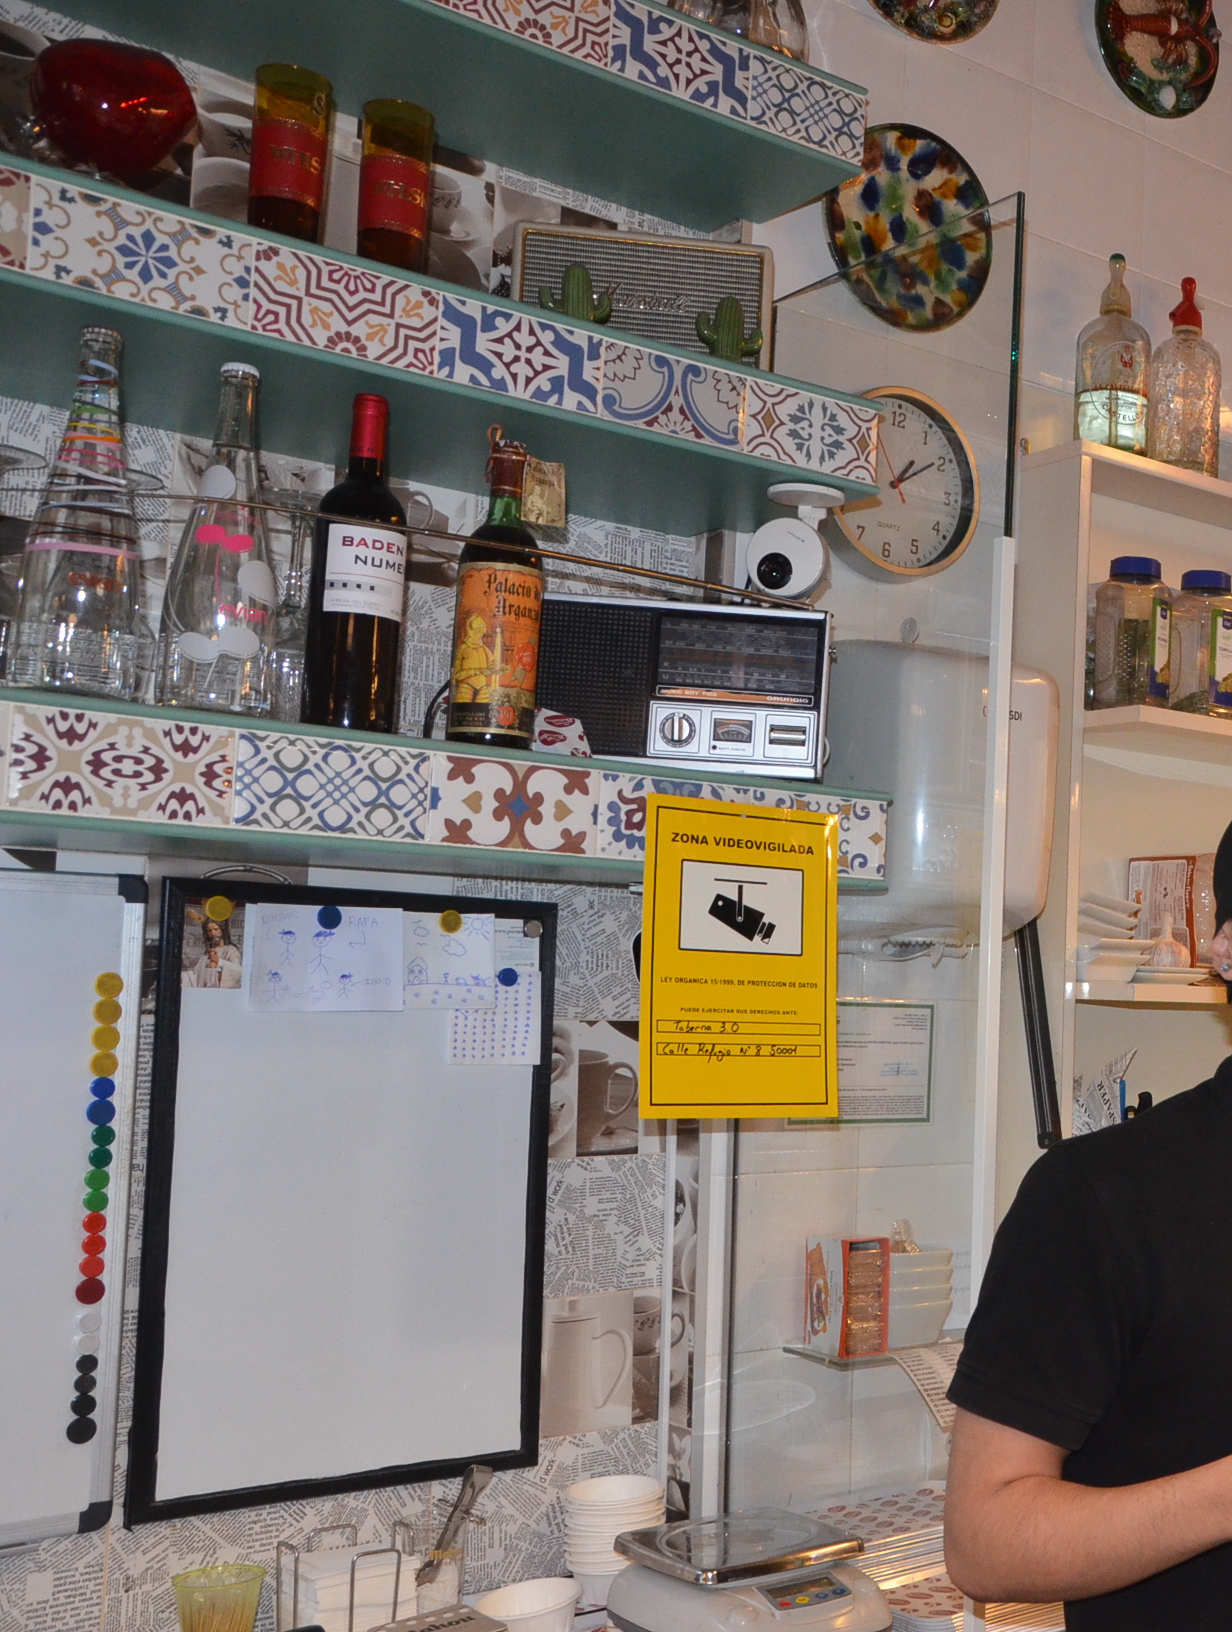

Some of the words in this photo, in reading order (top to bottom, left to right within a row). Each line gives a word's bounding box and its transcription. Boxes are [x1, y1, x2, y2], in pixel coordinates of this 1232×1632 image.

[891, 411, 906, 429] 12
[937, 456, 946, 472] 2
[944, 491, 952, 506] 3
[856, 525, 865, 541] 7
[877, 521, 900, 532] QUARTZ
[931, 521, 940, 535] 4
[342, 536, 404, 557] BADEN
[882, 542, 891, 558] 6
[910, 539, 919, 554] 5
[354, 554, 403, 574] NUME
[69, 571, 122, 593] evian
[484, 573, 532, 596] Palacio
[219, 602, 268, 624] evian
[671, 832, 709, 846] ZONA
[713, 836, 814, 855] VIDEOVIGILADA
[349, 916, 379, 927] RAFA
[673, 1021, 712, 1033] Taberna
[662, 1043, 688, 1055] Calle
[697, 1042, 731, 1063] Refugio
[755, 1046, 762, 1056] 8
